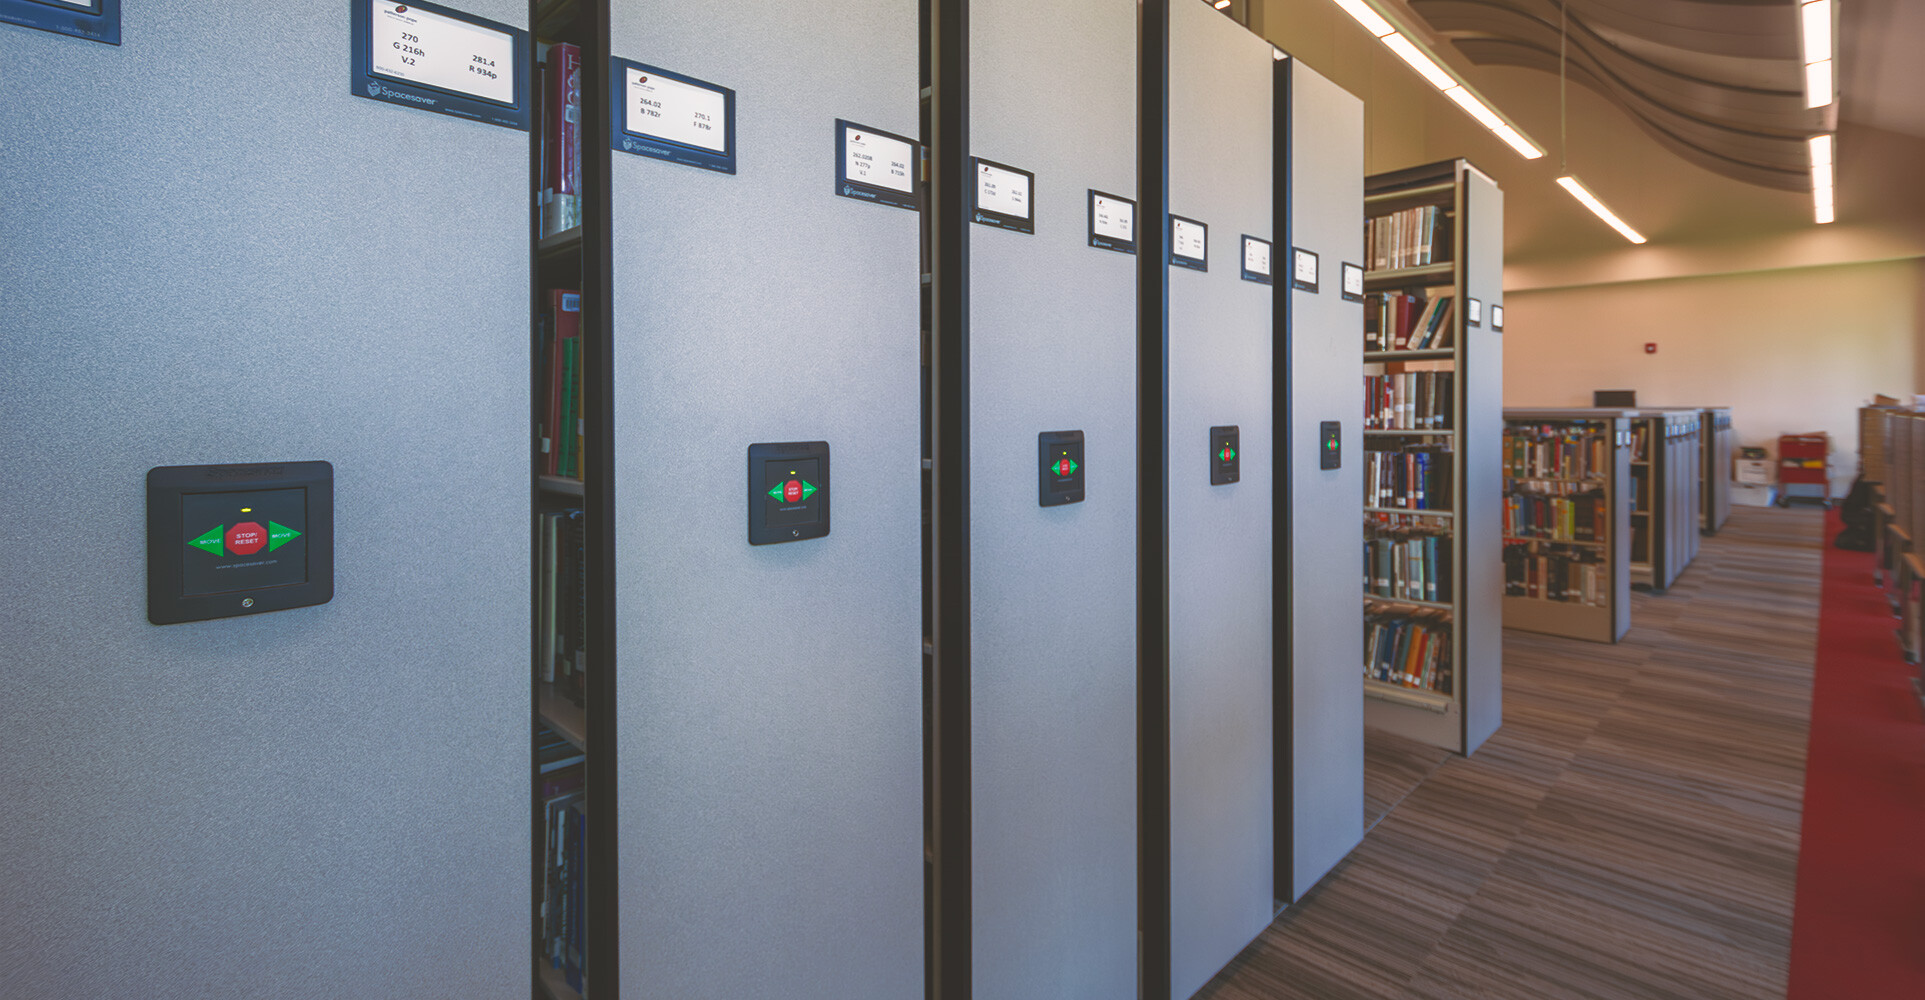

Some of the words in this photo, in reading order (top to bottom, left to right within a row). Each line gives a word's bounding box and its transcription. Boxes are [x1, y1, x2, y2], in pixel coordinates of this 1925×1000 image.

[401, 31, 419, 43] 270
[393, 41, 400, 50] G
[402, 44, 425, 57] 216h
[401, 55, 416, 66] V.2
[472, 54, 495, 67] 281.4
[469, 65, 475, 73] R
[476, 67, 497, 80] 934p
[381, 86, 436, 105] Spacesaver
[632, 141, 671, 156] Spacesaver
[200, 537, 221, 545] MOVE
